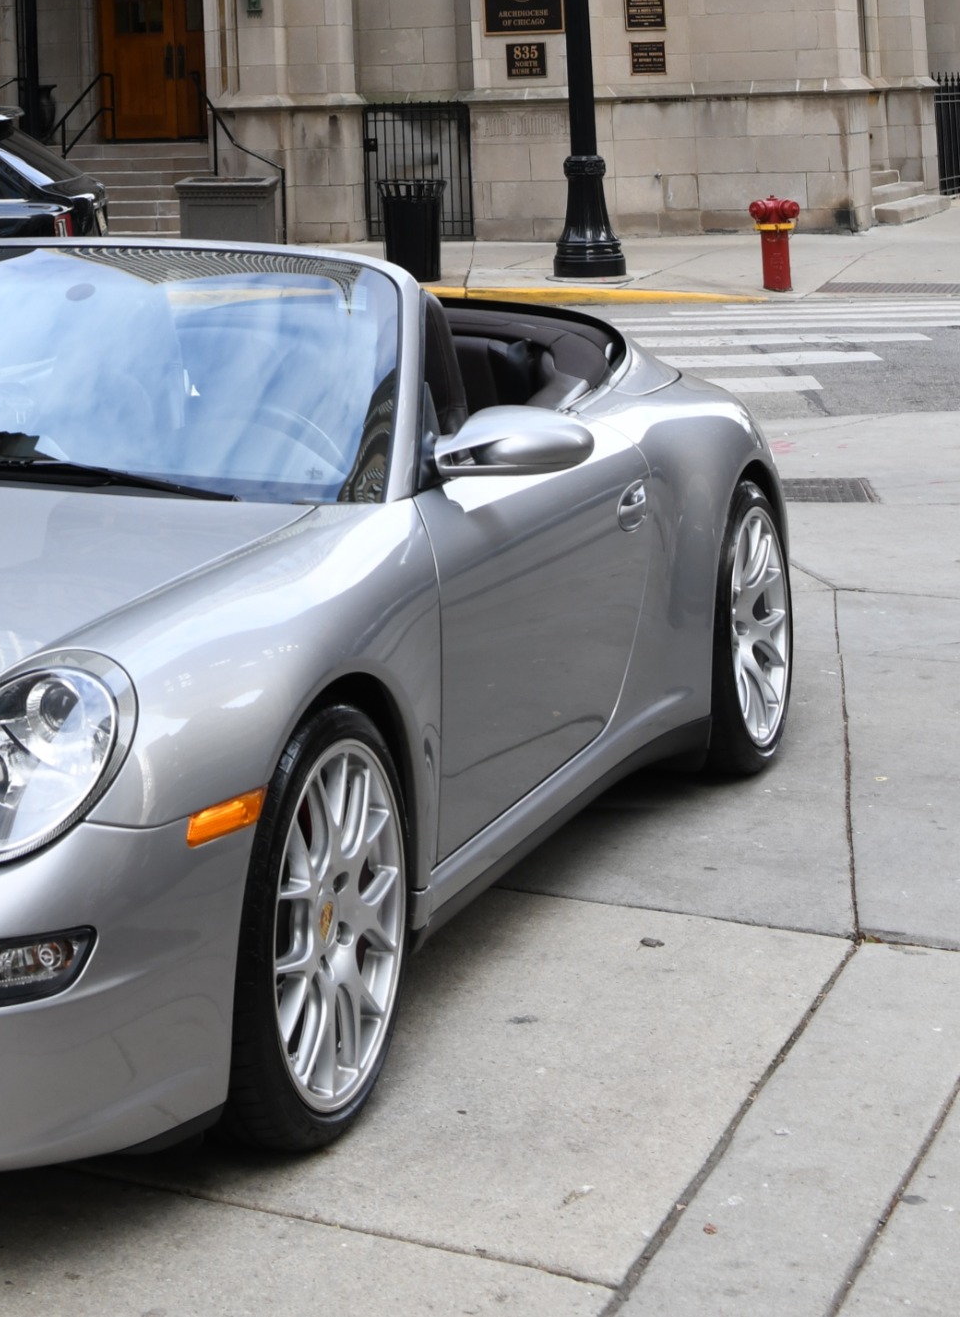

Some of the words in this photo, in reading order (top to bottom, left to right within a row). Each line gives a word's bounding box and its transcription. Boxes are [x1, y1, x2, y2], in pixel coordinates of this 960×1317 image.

[498, 9, 549, 18] ARCHDIOCESE
[512, 18, 545, 26] CHICAGO
[513, 45, 538, 60] 835
[514, 60, 538, 68] NORTH
